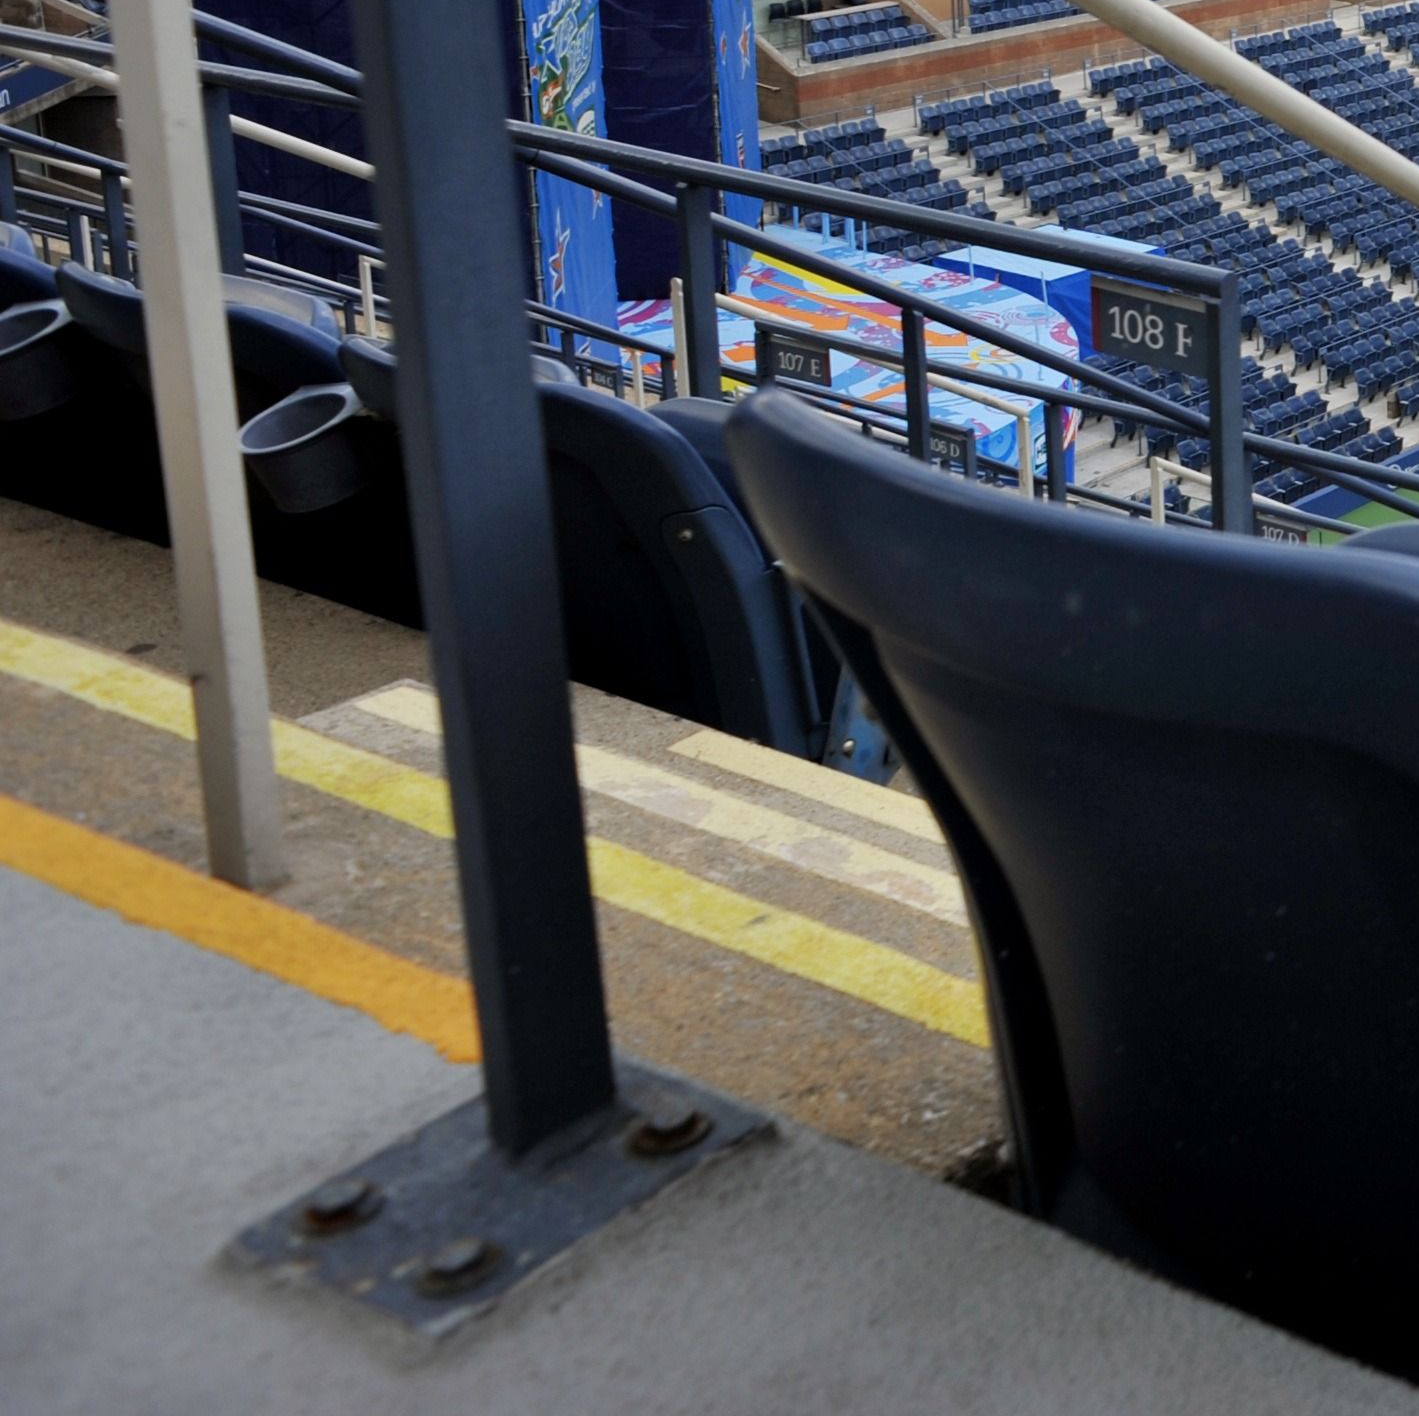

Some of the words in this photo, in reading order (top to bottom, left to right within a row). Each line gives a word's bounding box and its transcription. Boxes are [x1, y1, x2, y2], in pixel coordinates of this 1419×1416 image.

[1108, 305, 1165, 350] 108
[1174, 322, 1193, 358] F
[776, 350, 805, 372] 107
[810, 358, 823, 378] E
[950, 441, 960, 458] D
